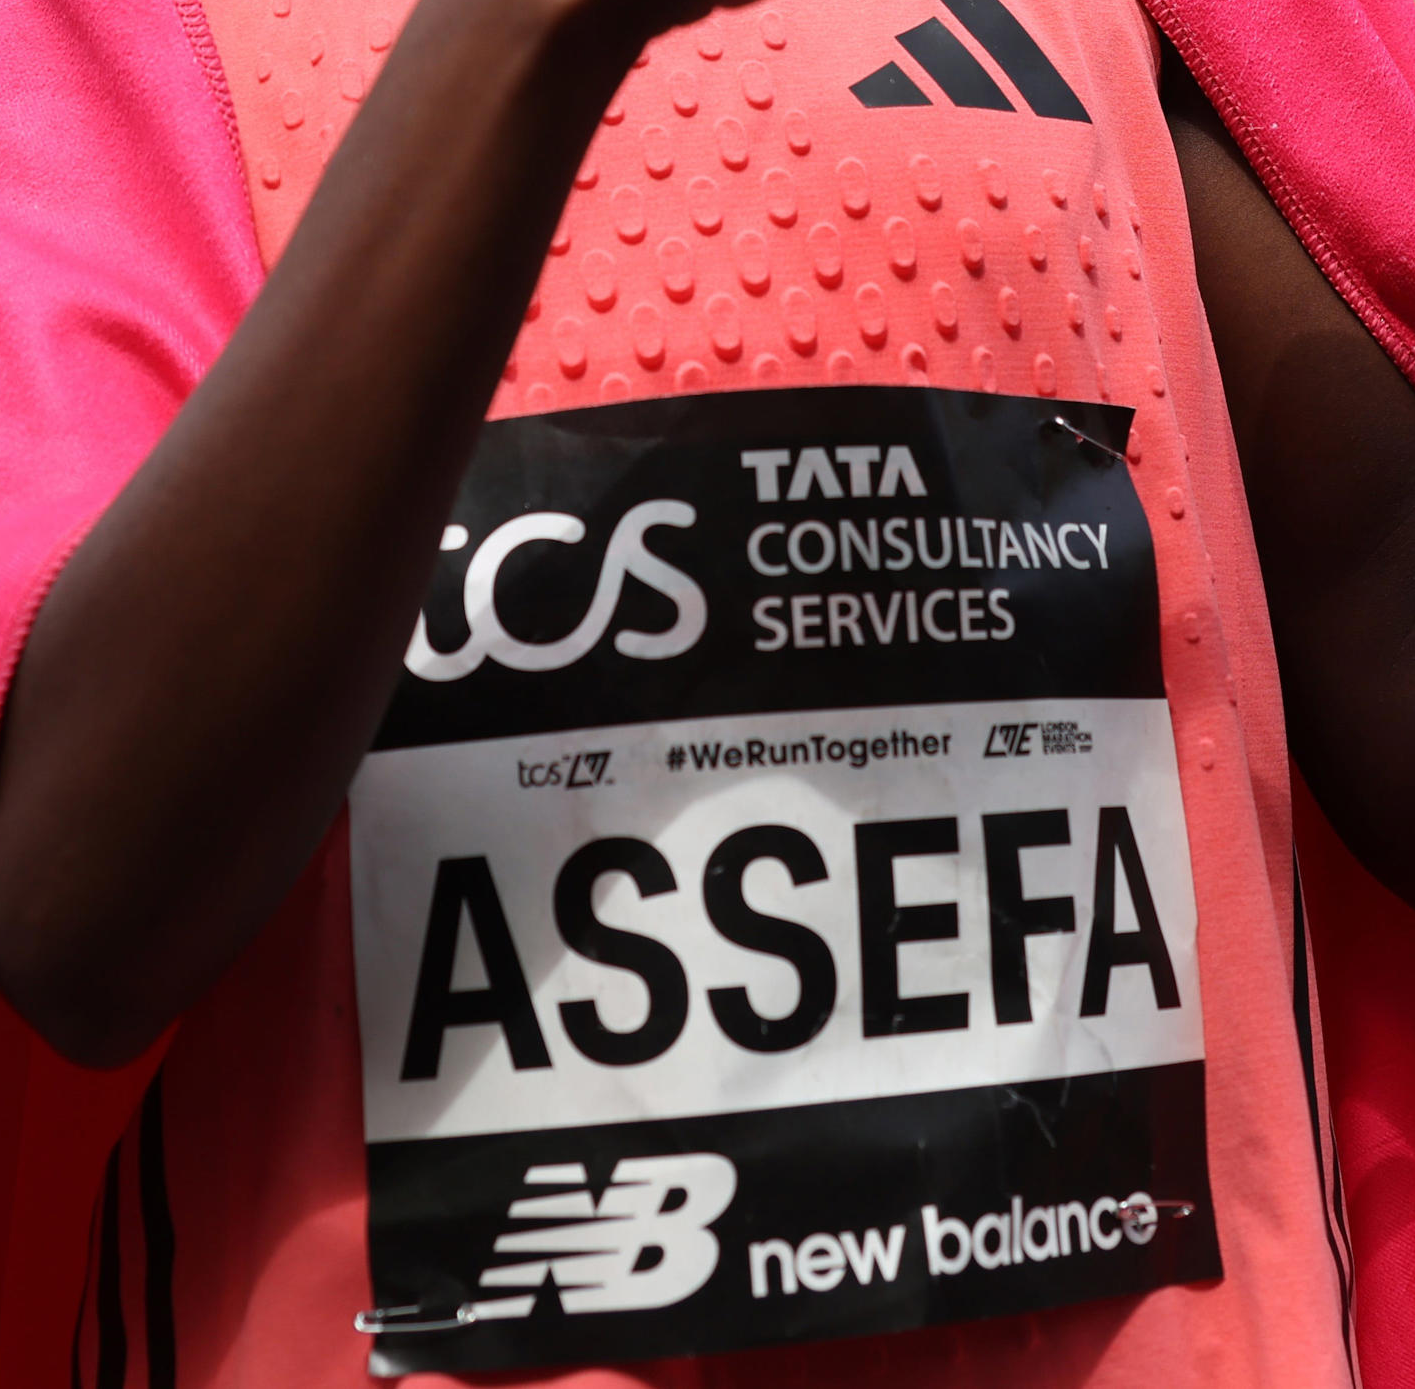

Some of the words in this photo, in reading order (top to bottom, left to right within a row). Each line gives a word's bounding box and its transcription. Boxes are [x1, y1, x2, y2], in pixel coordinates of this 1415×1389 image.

[741, 445, 927, 503] TATA
[747, 517, 1110, 577] CONSULTANCY
[753, 587, 1016, 651] SERVICES
[517, 759, 562, 789] tcs
[666, 729, 952, 772] #WeRunTogether
[399, 806, 1181, 1082] ASSEFA
[472, 1152, 737, 1319] NB
[748, 1223, 906, 1298] new
[920, 1191, 1159, 1275] balance
